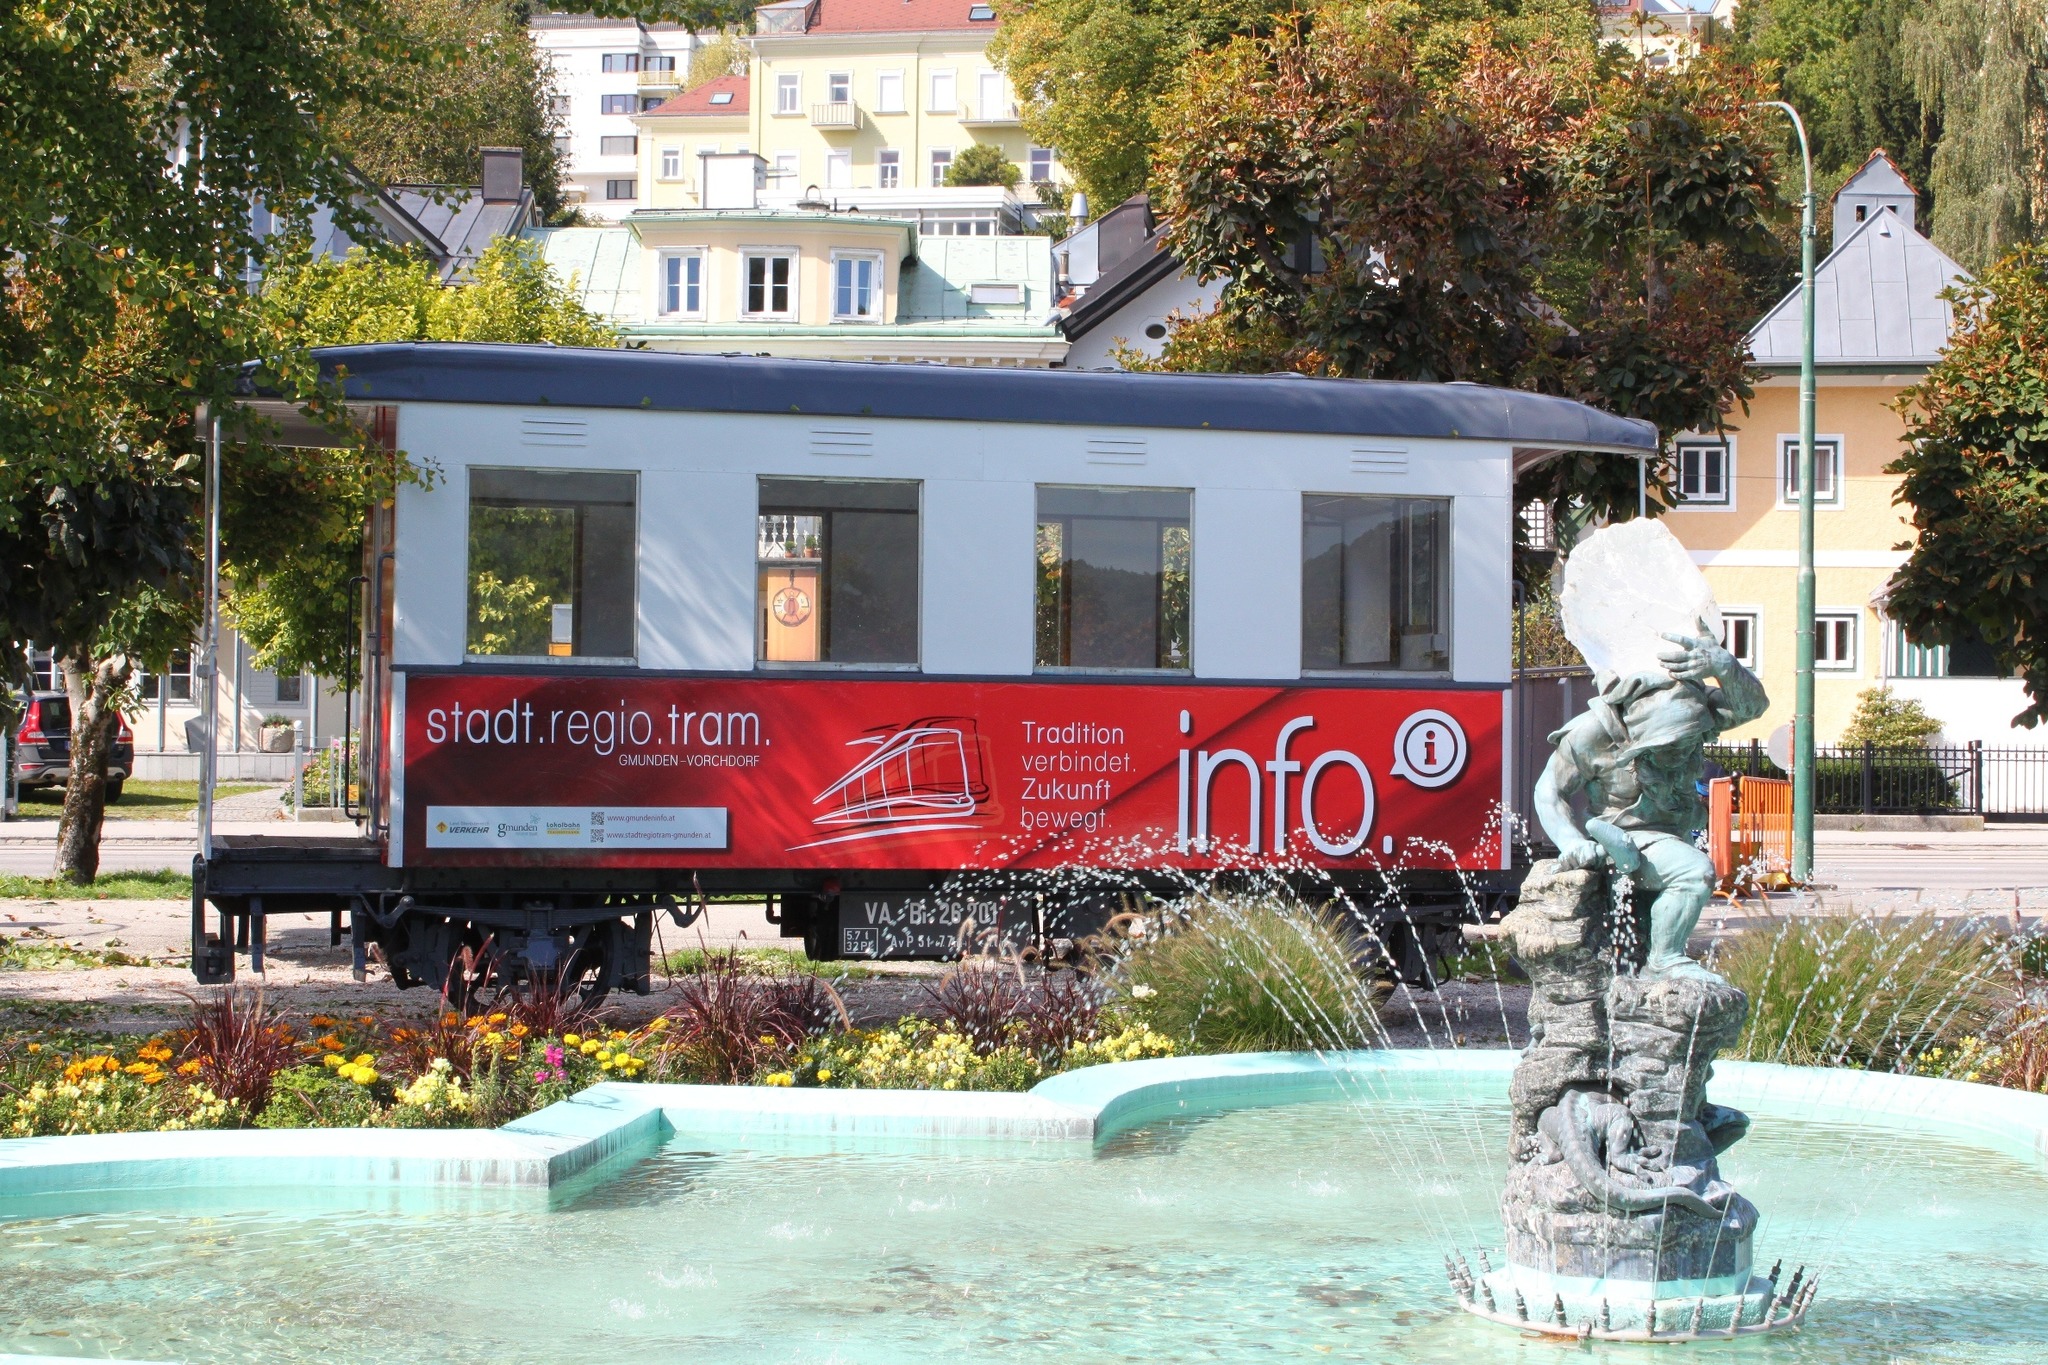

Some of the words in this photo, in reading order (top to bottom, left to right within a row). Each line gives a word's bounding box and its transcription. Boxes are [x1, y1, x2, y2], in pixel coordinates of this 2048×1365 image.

[426, 698, 771, 756] stadt.regio.tram.
[1021, 721, 1125, 745] Tradition
[1021, 751, 1137, 773] verbindet.
[1021, 777, 1112, 801] Zukunft
[1177, 709, 1393, 857] info.
[607, 814, 676, 823] www.gmundeninfo.at
[1021, 806, 1113, 833] bewegt.
[449, 826, 490, 834] VERKEHR
[497, 822, 538, 838] gmunden
[606, 831, 711, 840] www.stadtregiotram-gmunden.at
[864, 902, 892, 925] VA
[939, 902, 961, 925] 26
[846, 930, 861, 941] 5.7
[846, 941, 859, 952] 32
